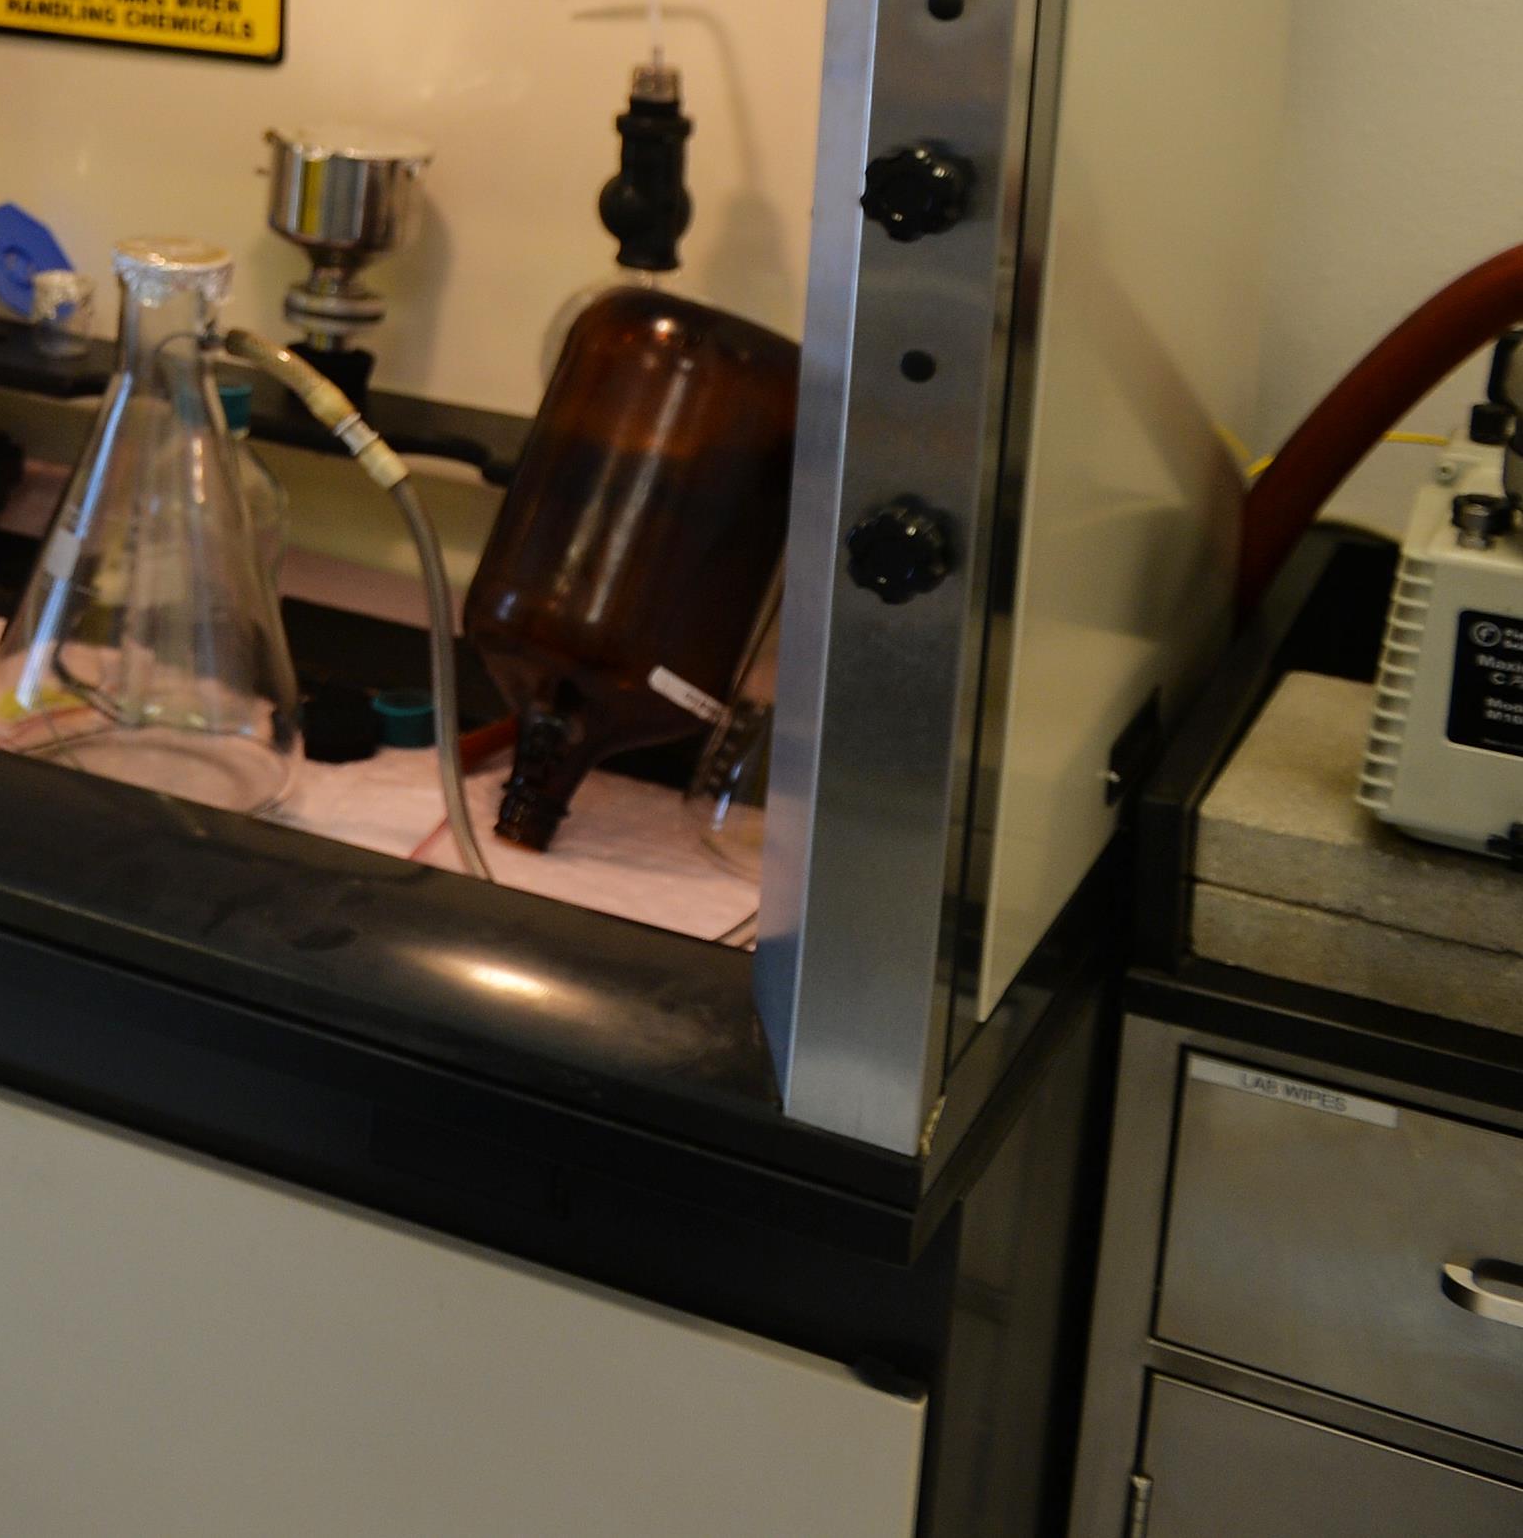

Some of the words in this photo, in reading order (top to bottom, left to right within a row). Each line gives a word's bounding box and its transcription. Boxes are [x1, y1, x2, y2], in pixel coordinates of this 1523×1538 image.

[126, 10, 254, 40] CHEMICALS
[1241, 1072, 1279, 1095] LAB
[1285, 1084, 1348, 1112] WIPES
